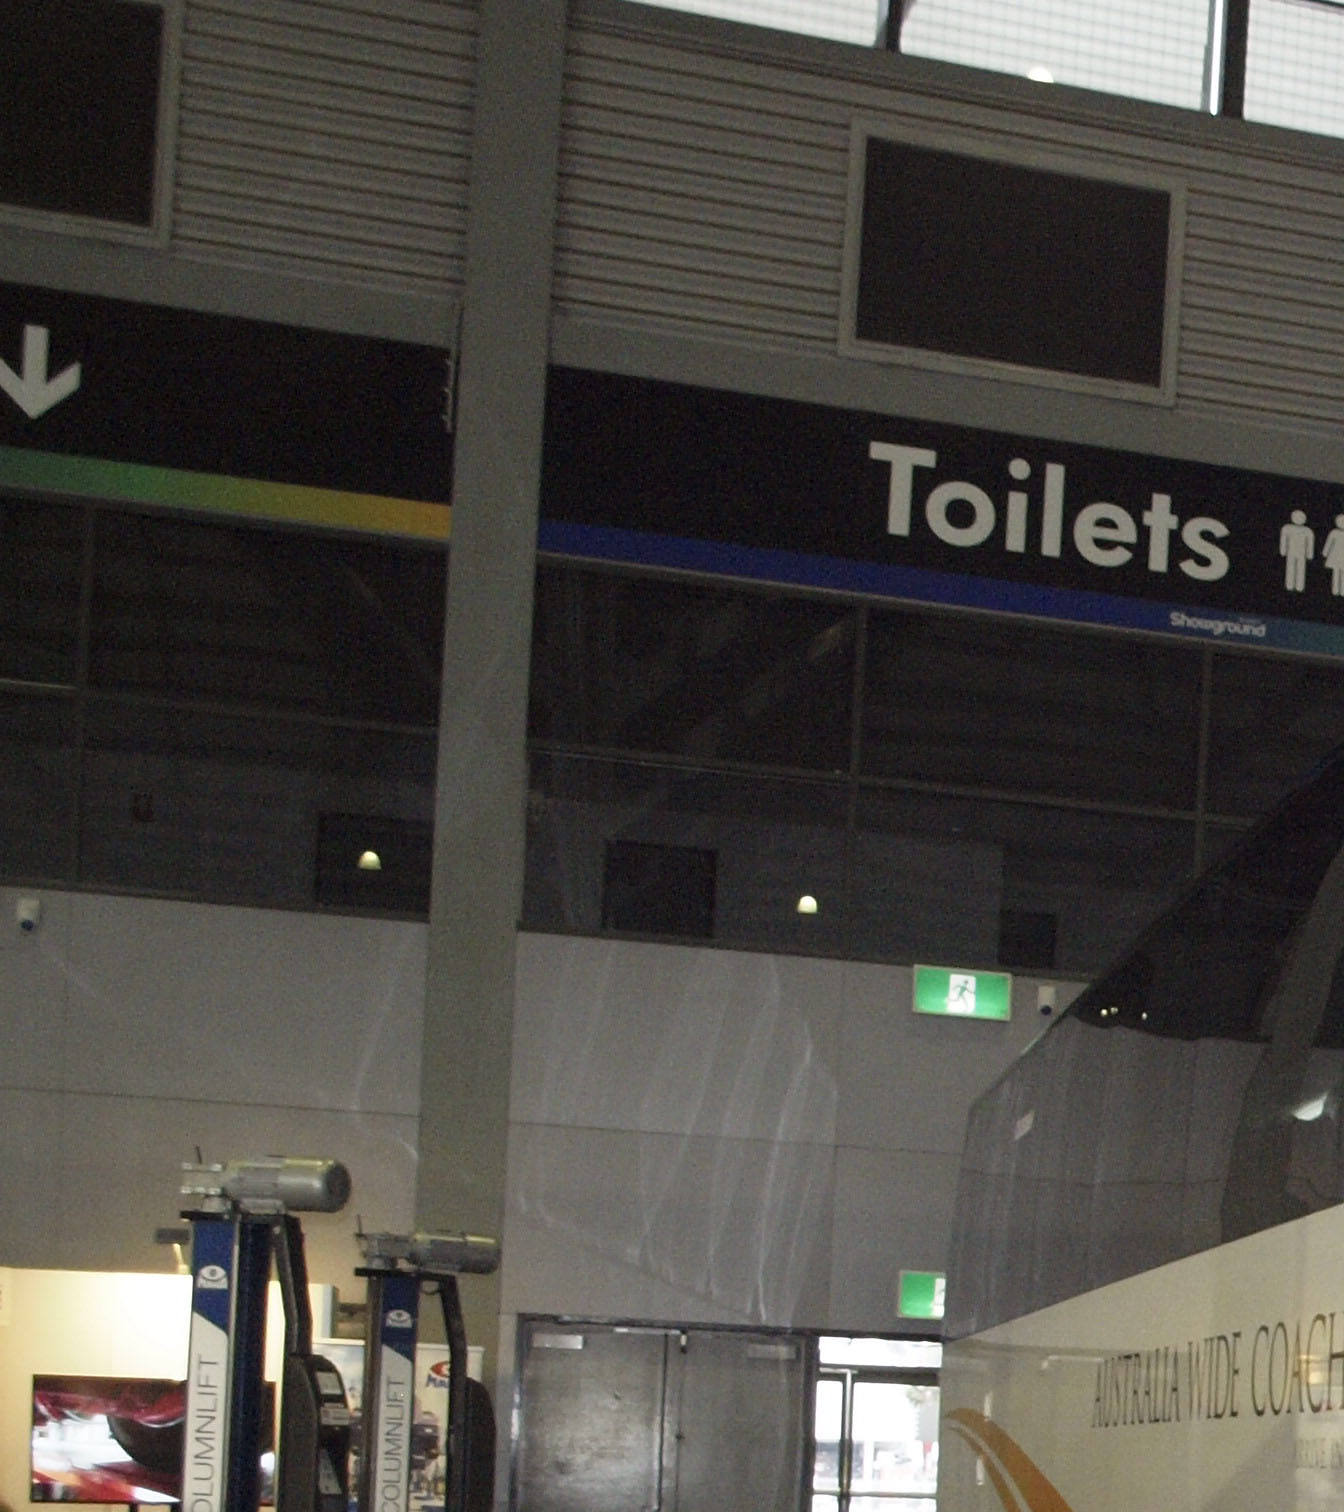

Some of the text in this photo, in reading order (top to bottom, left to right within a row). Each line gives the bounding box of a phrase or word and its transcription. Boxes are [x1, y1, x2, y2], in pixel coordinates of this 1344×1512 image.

[869, 441, 1232, 583] Toilets
[1169, 610, 1267, 638] Showground
[1092, 1346, 1181, 1428] AUSTRALIA
[1187, 1332, 1242, 1420] WIDE
